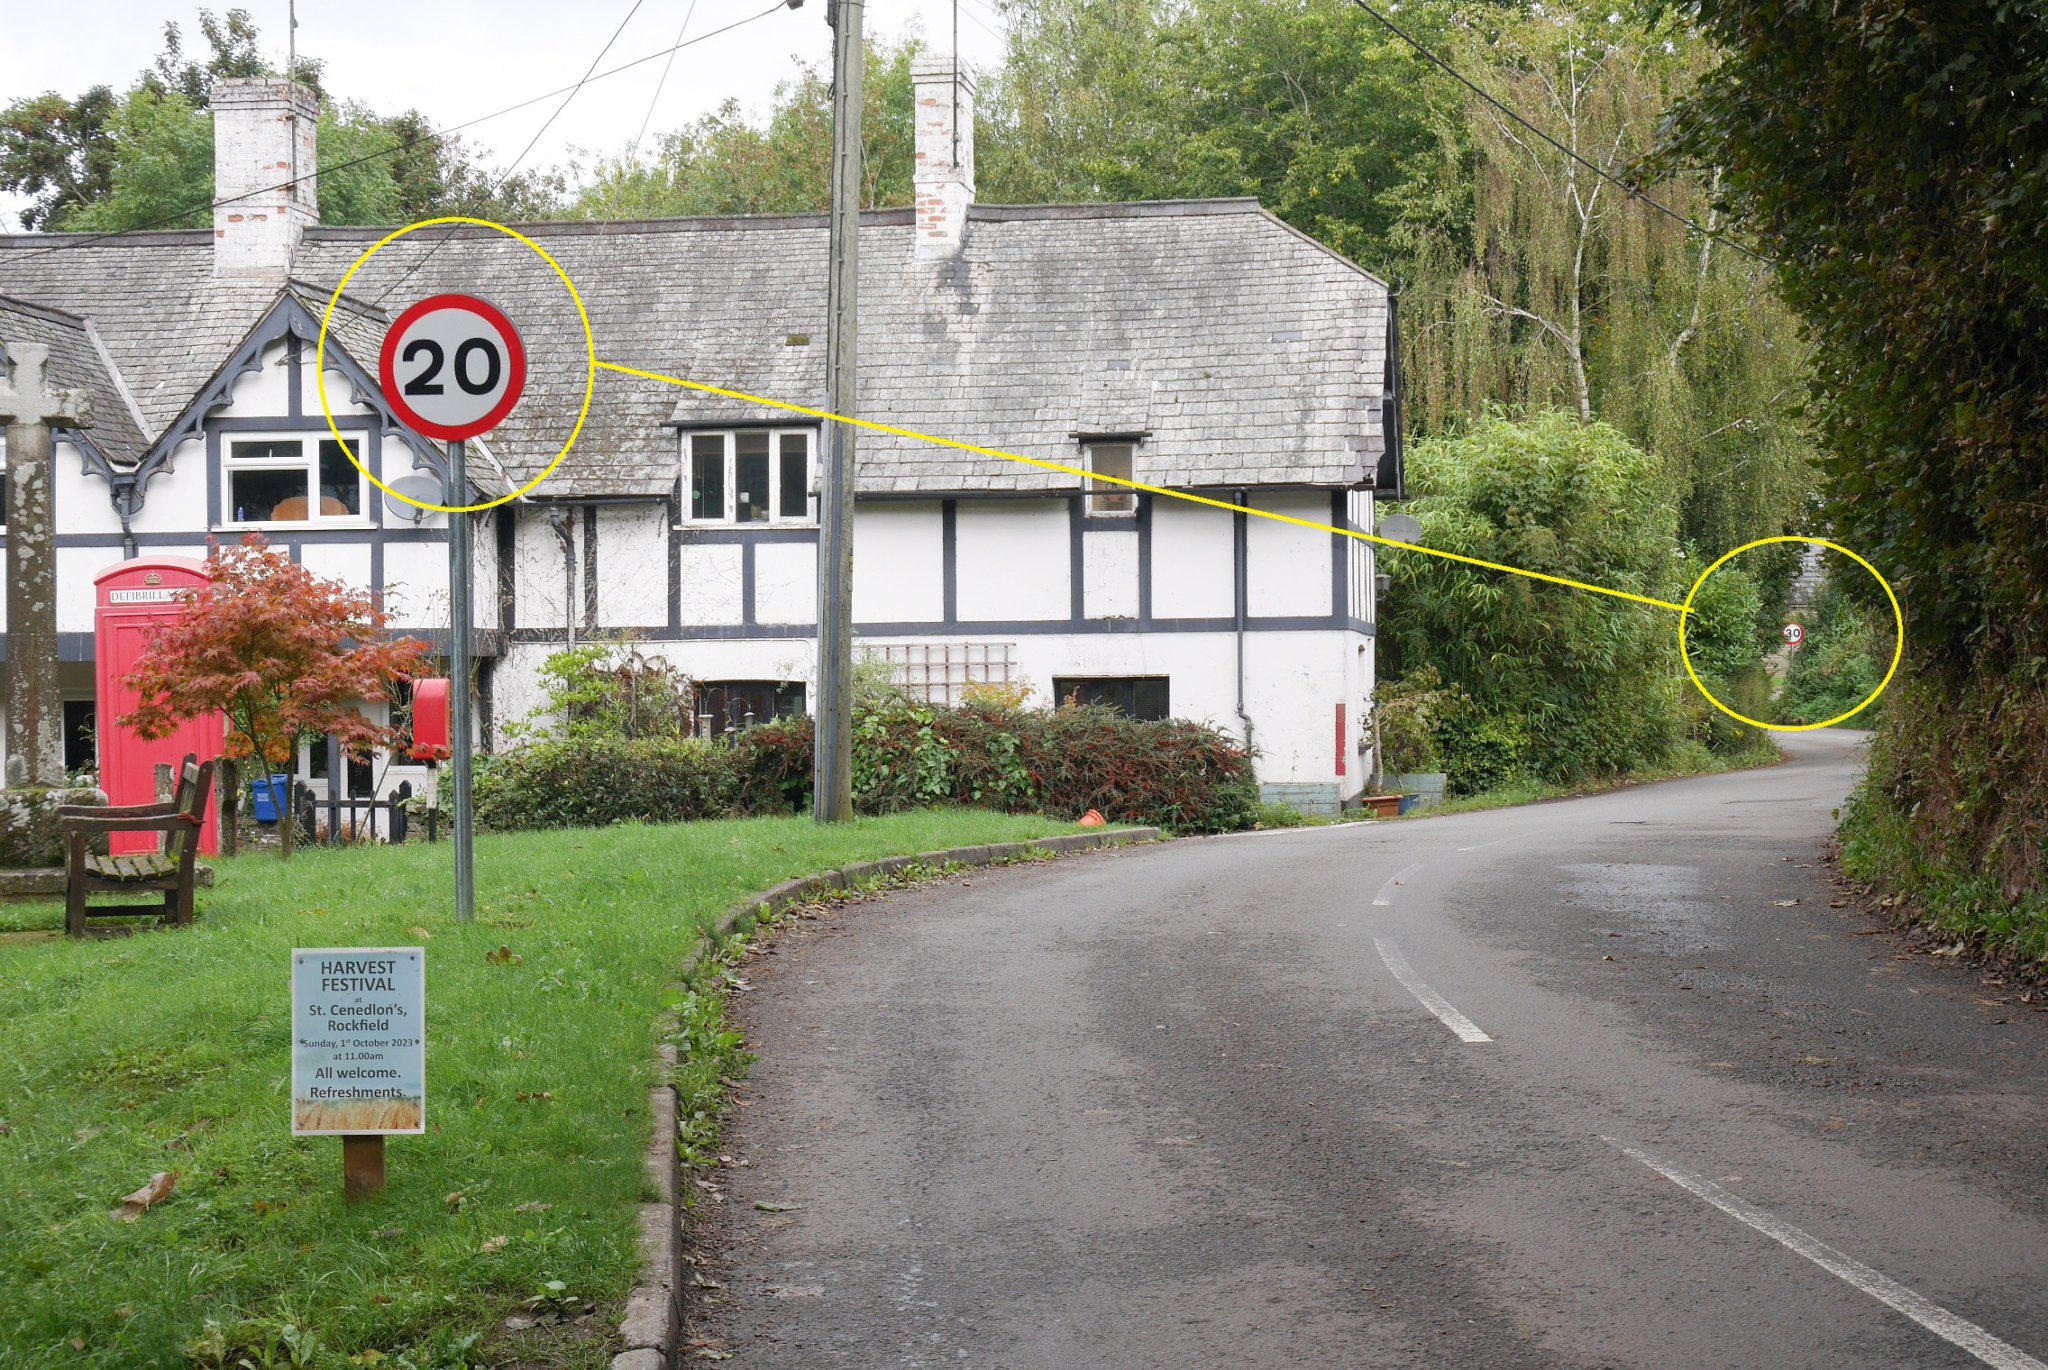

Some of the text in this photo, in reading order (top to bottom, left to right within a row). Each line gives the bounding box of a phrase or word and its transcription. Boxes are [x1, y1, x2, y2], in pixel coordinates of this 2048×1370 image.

[402, 337, 501, 396] 20
[1786, 629, 1800, 637] 30
[321, 961, 396, 974] HARVEST
[322, 978, 395, 991] FESTIVAL
[309, 1003, 407, 1017] St. Cenedlon's,
[328, 1019, 389, 1031] Rockfield
[303, 1040, 338, 1048] Sunday,
[353, 1039, 389, 1047] October
[391, 1039, 413, 1047] 2023
[333, 1052, 384, 1060] at 11.00am
[315, 1066, 401, 1079] All welcome.
[310, 1086, 406, 1098] Refreshments.
